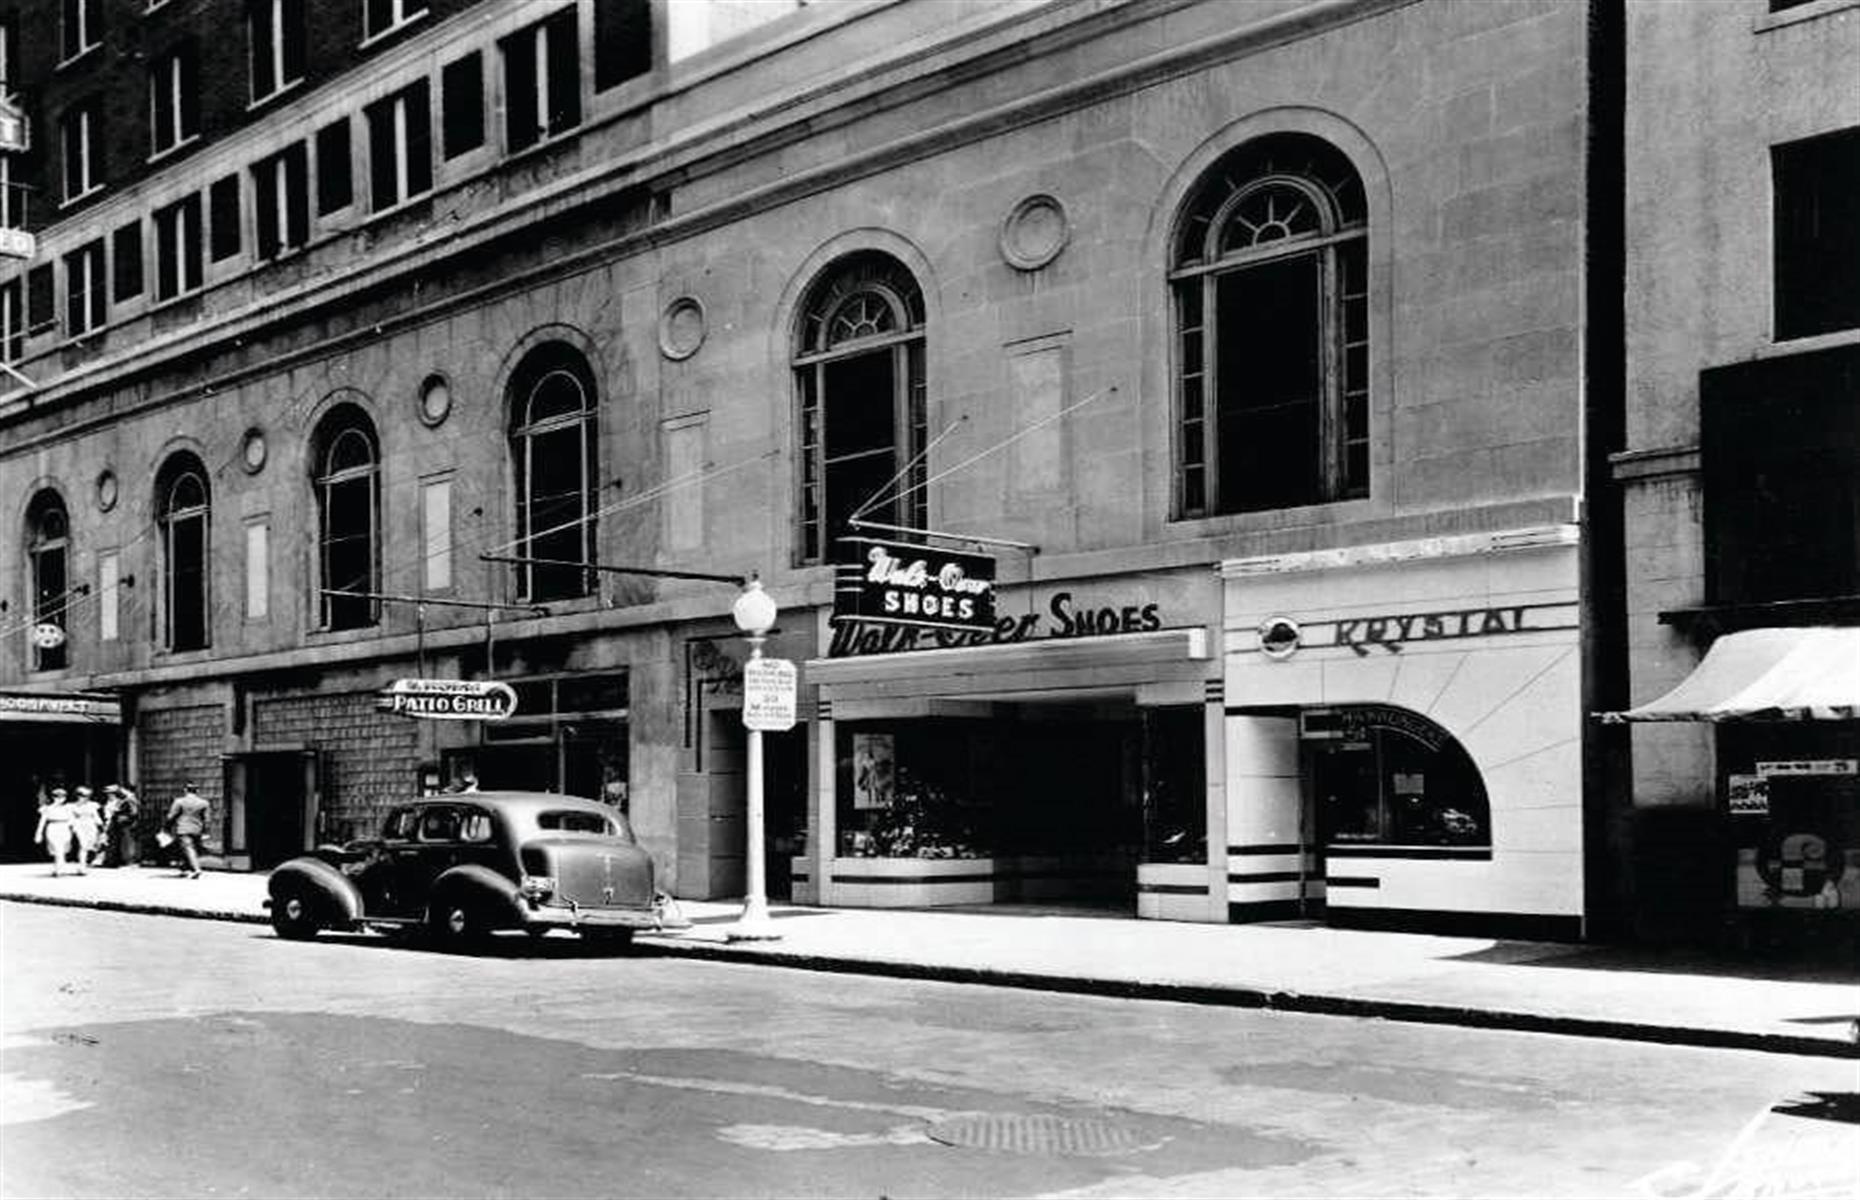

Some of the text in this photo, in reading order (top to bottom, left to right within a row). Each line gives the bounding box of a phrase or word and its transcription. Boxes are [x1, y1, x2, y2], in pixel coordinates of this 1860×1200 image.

[884, 590, 974, 619] SHOES
[1335, 606, 1541, 657] KRYSTAL
[393, 694, 504, 713] PATIO GRILL
